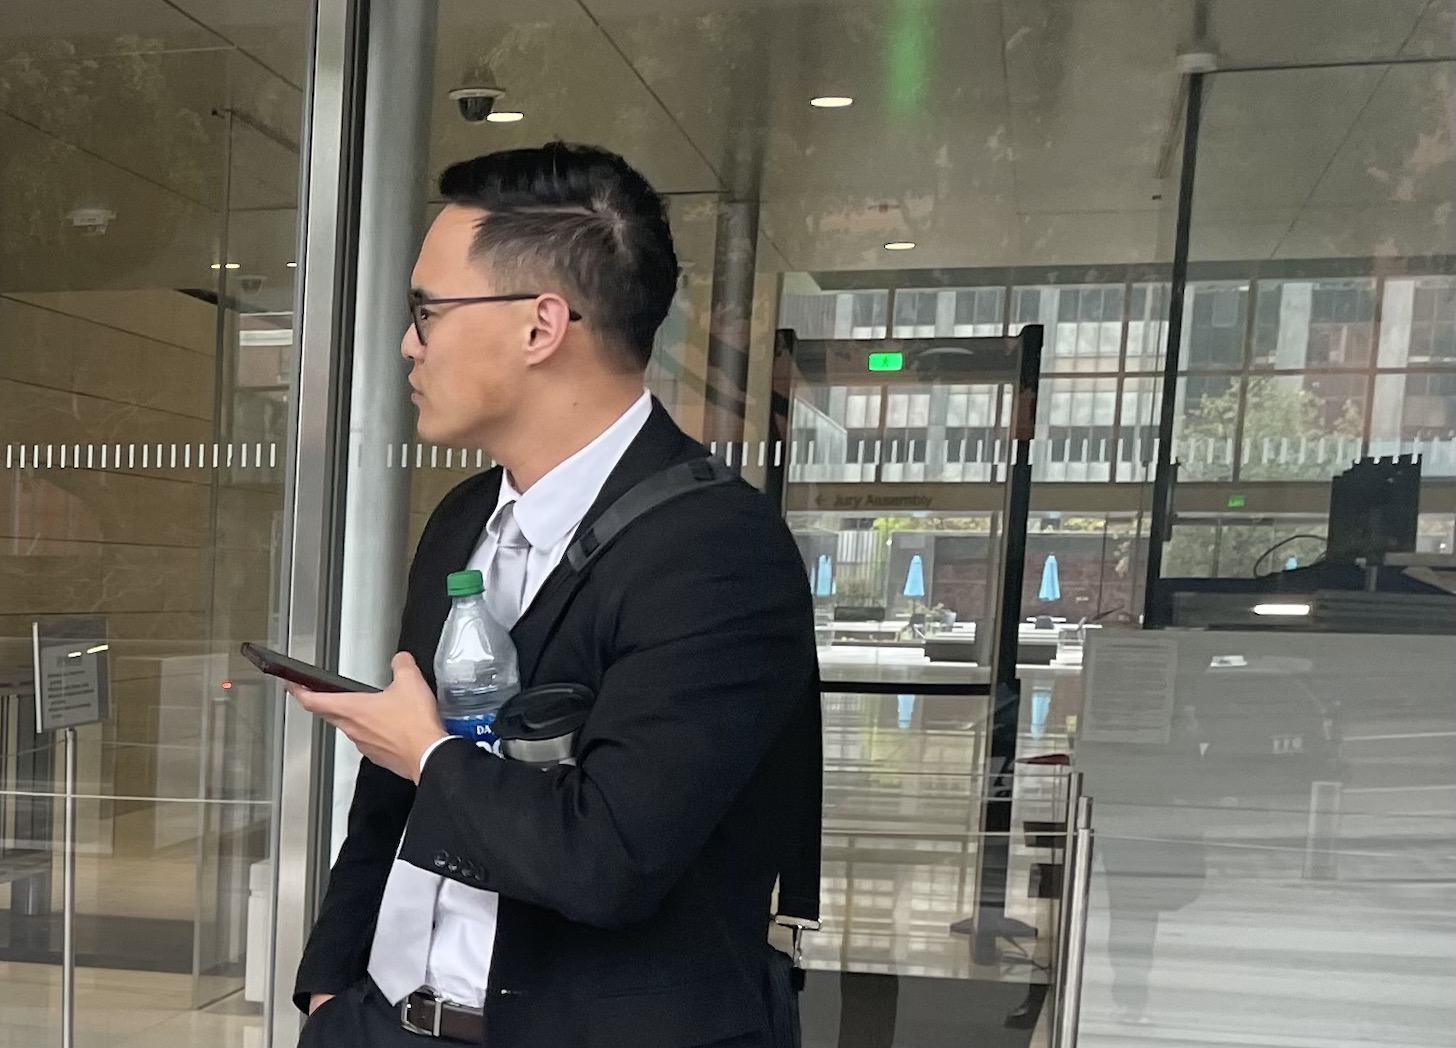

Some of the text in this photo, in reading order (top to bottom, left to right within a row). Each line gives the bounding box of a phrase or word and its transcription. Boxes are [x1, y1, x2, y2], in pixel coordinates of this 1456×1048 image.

[833, 494, 932, 508] Jury Assembly
[476, 725, 495, 736] DA
